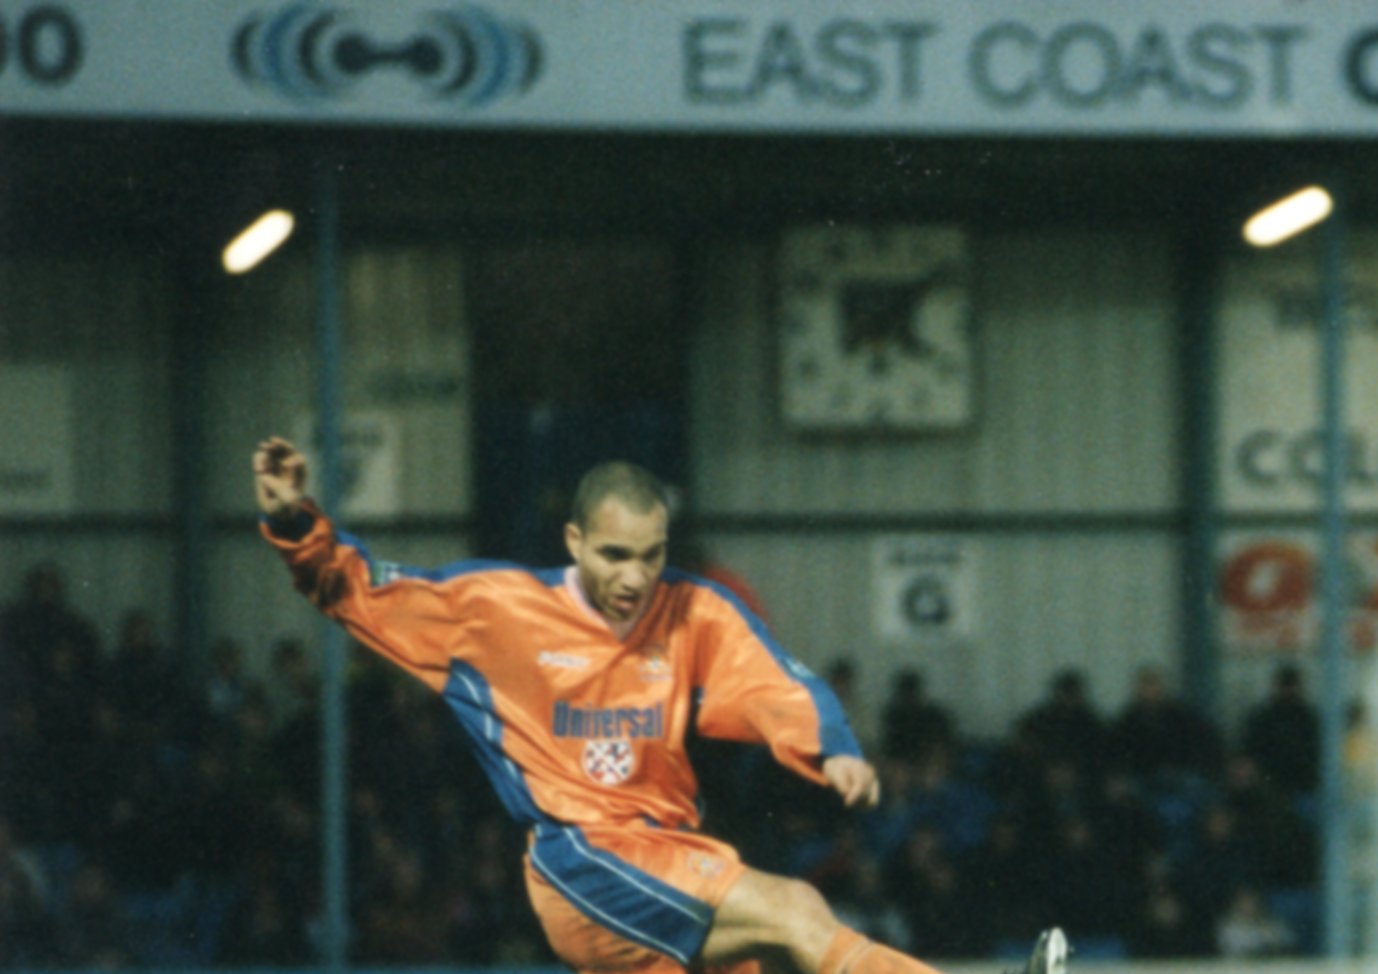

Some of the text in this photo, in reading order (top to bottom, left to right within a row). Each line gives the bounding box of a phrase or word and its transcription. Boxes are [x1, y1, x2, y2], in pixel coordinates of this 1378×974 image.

[0, 6, 84, 86] 0
[683, 20, 938, 105] EAST
[967, 20, 1307, 108] COAST
[553, 700, 664, 739] Universal
